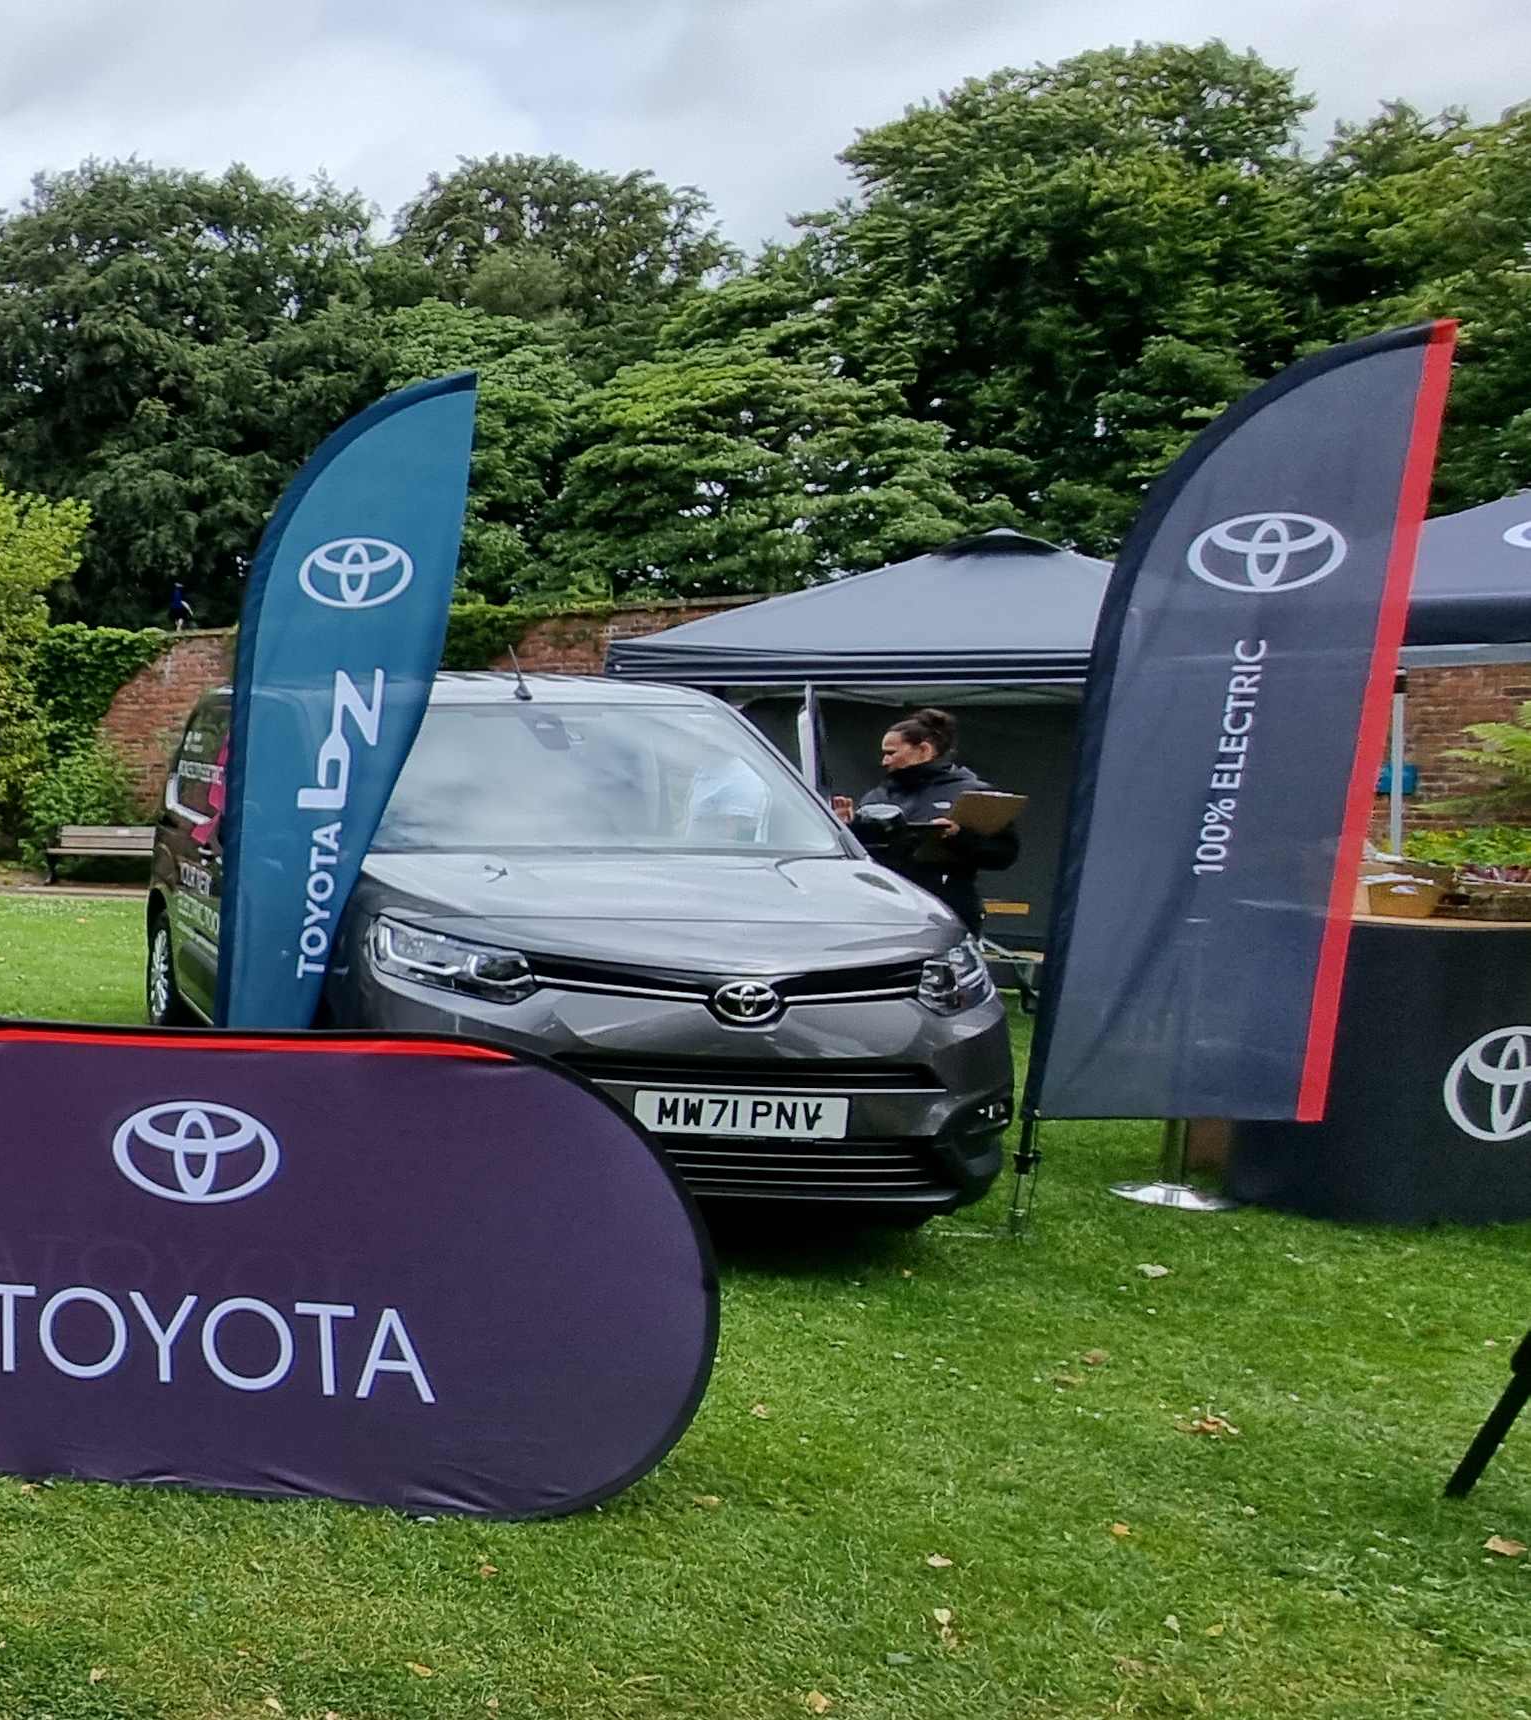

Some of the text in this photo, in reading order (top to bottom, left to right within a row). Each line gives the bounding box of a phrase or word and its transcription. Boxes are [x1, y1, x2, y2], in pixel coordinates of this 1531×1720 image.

[1192, 639, 1267, 875] 100% ELECTRIC
[296, 821, 342, 980] TOYOTA
[657, 1097, 822, 1131] MW71 PNV
